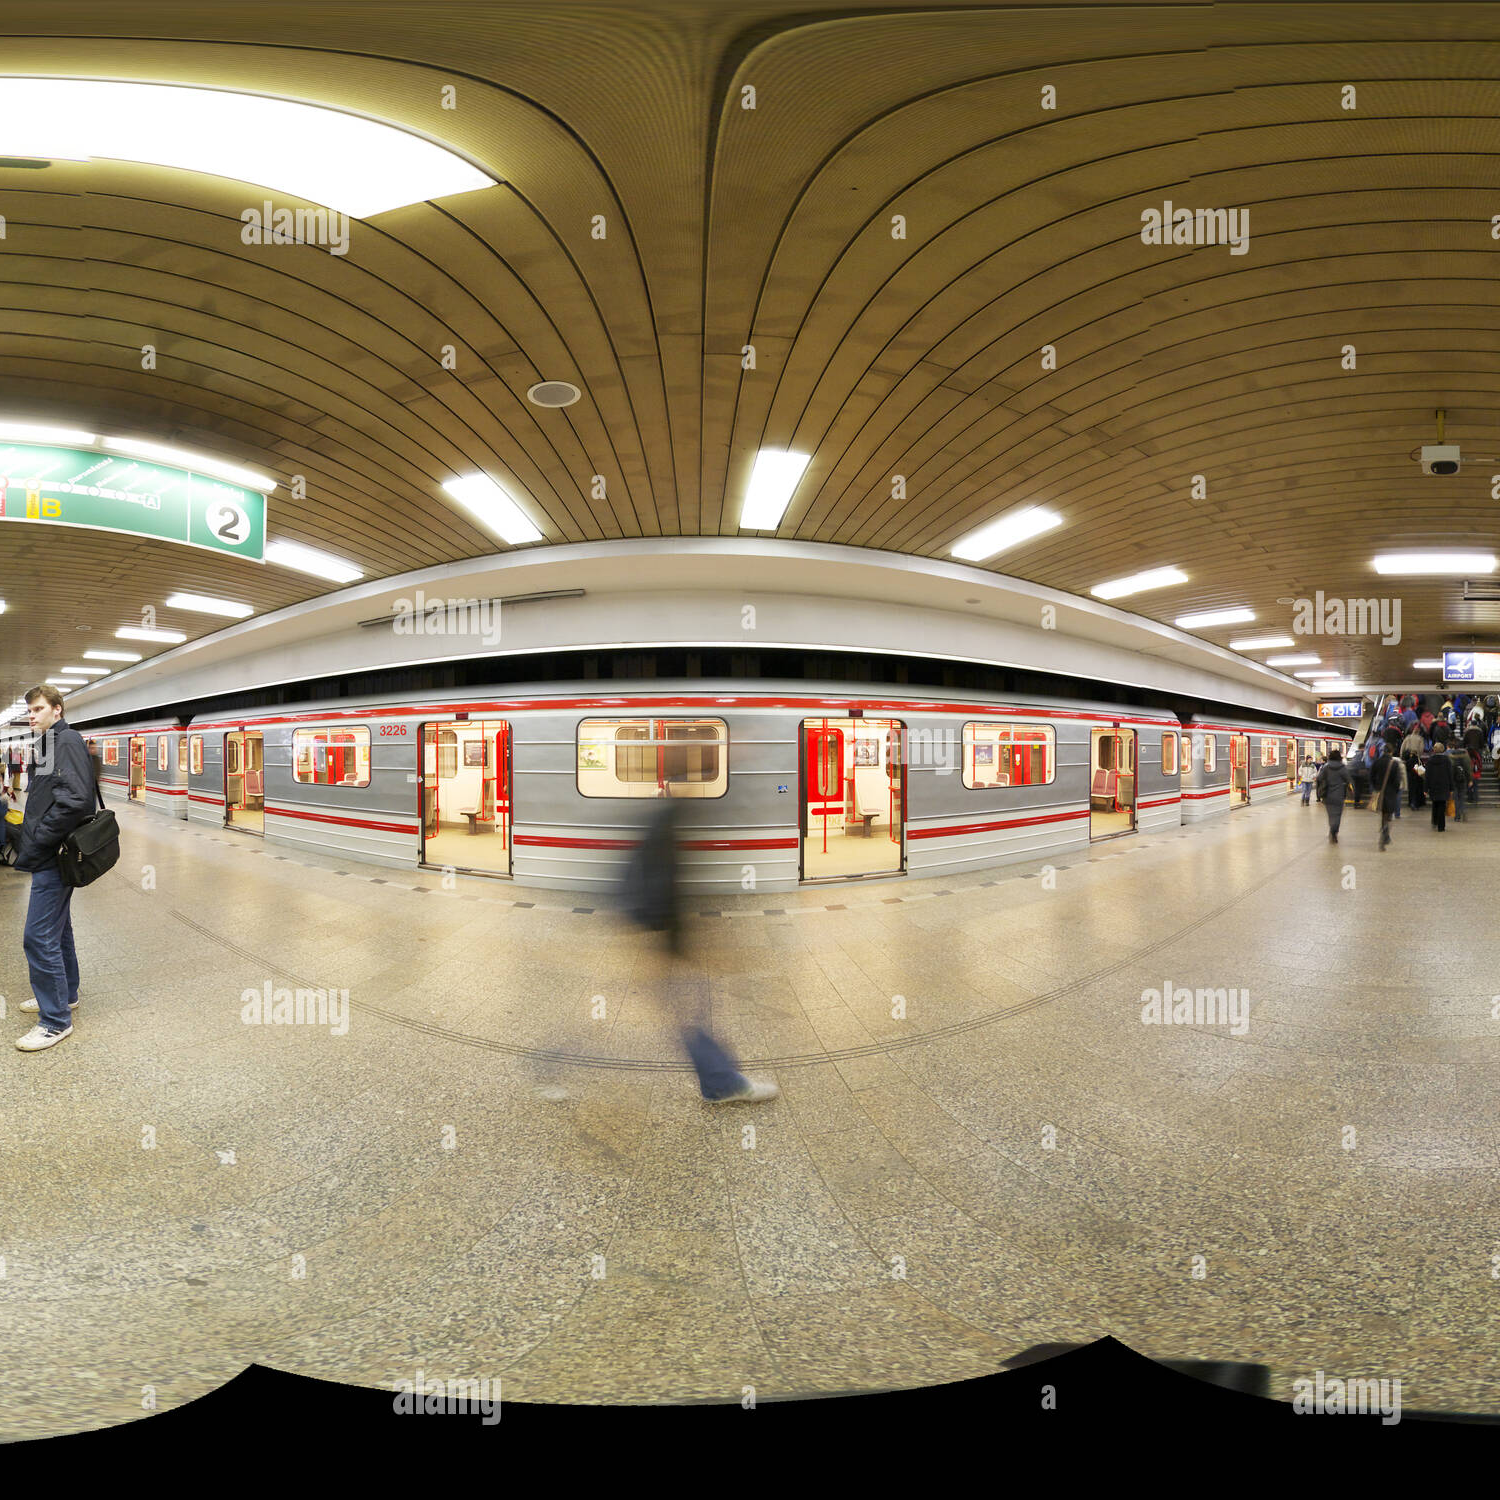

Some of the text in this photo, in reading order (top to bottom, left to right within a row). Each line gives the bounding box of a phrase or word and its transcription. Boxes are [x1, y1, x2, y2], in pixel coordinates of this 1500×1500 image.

[42, 497, 62, 517] B
[146, 496, 156, 507] A
[217, 506, 240, 540] 2
[380, 725, 407, 736] 3226
